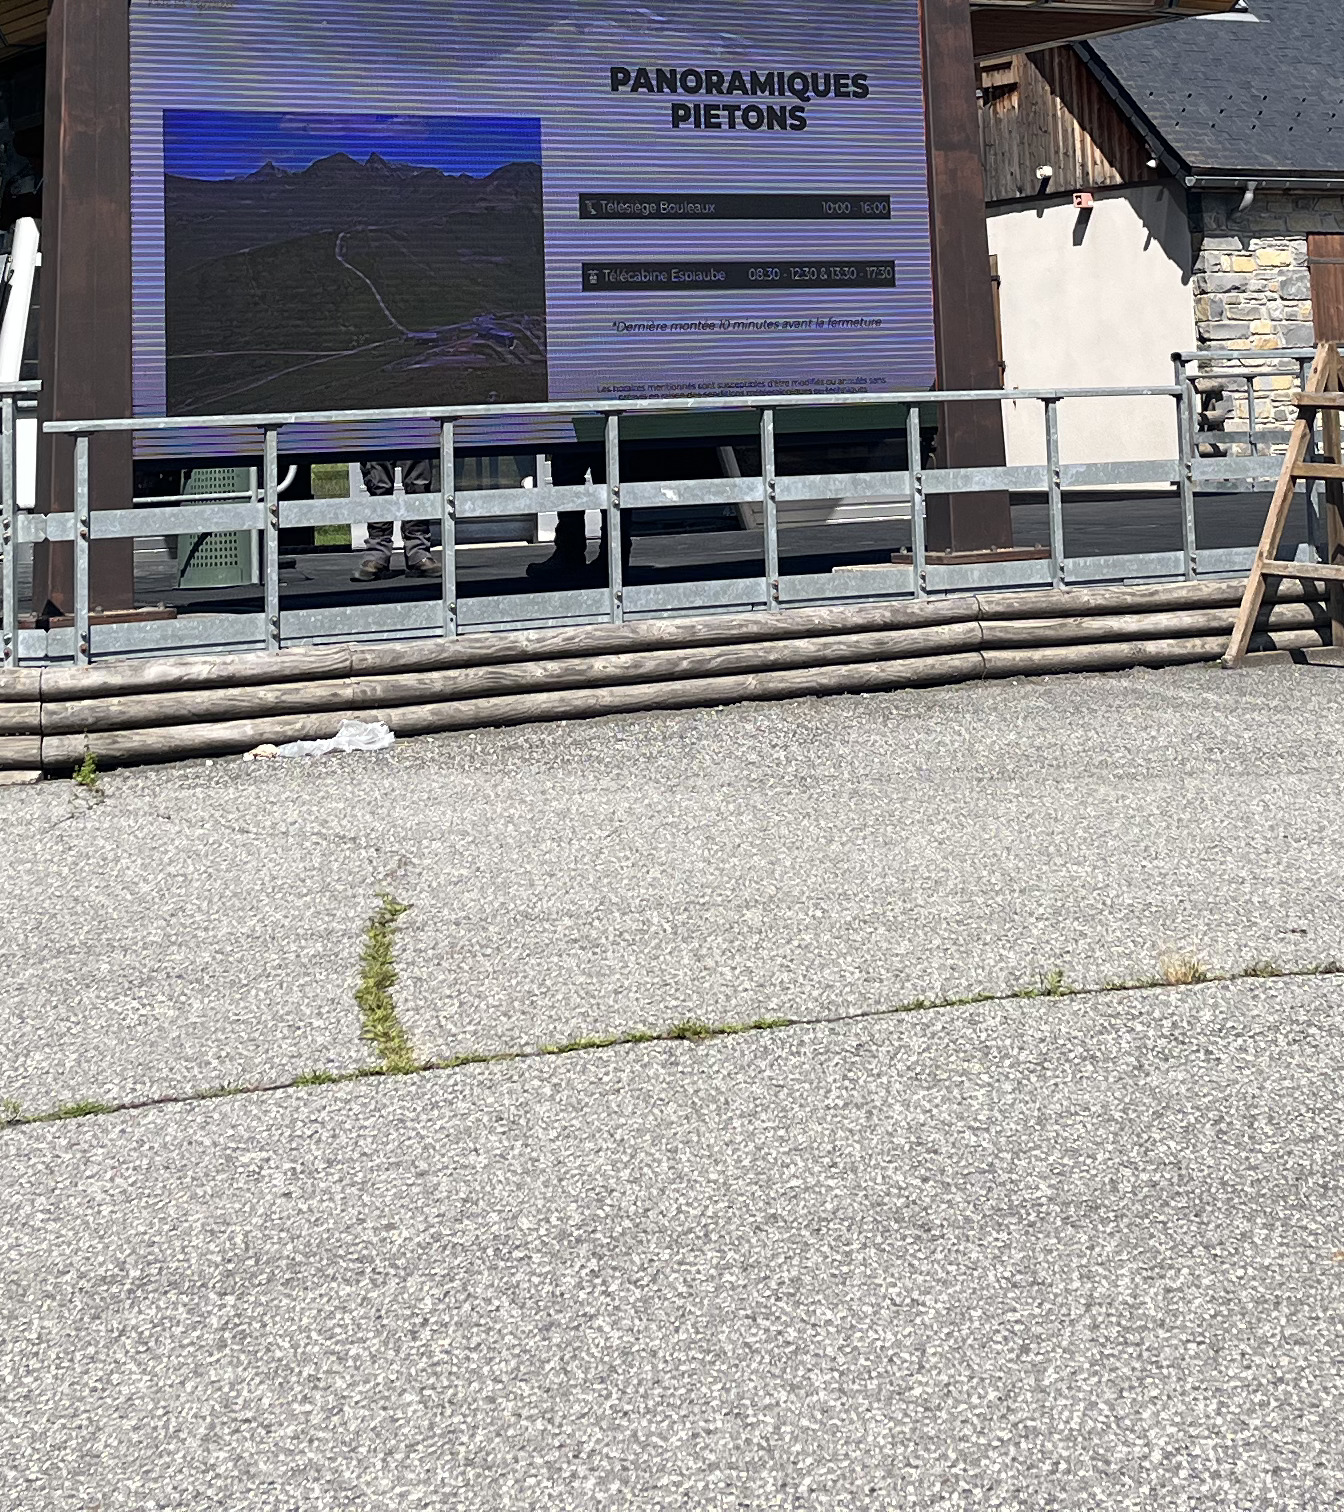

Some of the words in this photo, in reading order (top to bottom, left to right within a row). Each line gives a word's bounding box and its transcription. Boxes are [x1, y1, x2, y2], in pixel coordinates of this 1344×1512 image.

[609, 66, 870, 102] PANORAMIQUES
[670, 102, 808, 131] PIETONS
[659, 199, 716, 214] Bouleaux
[602, 268, 668, 283] Télécabine
[670, 267, 726, 284] Espiaube
[819, 267, 828, 280] &
[732, 317, 780, 331] minutes
[781, 318, 813, 329] avant
[815, 317, 825, 329] la
[827, 316, 883, 329] fermeture
